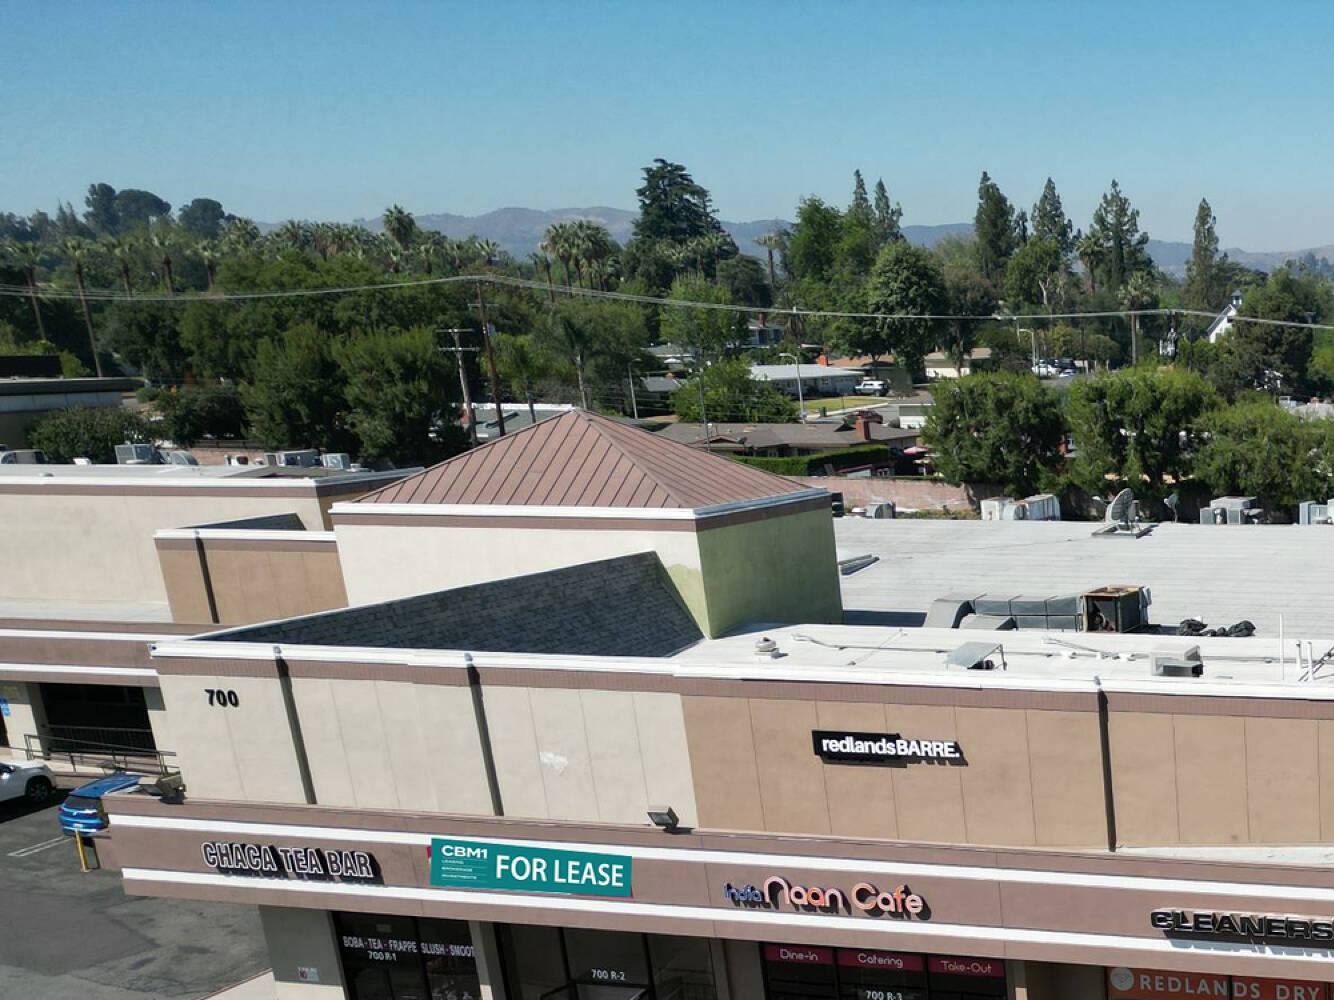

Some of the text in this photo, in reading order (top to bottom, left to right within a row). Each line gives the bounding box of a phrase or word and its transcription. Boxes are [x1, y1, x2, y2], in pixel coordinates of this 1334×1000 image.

[204, 689, 240, 708] 700
[201, 842, 373, 877] CHACA TEA BAR
[441, 845, 488, 859] CBM1
[496, 855, 624, 887] FOR LEASE
[723, 882, 762, 902] India
[367, 951, 385, 961] 700
[857, 953, 904, 969] Catering
[591, 969, 626, 980] 700 R-2
[940, 960, 993, 974] Take-Out
[1139, 973, 1261, 998] REDLANDS
[866, 989, 885, 1000] 700
